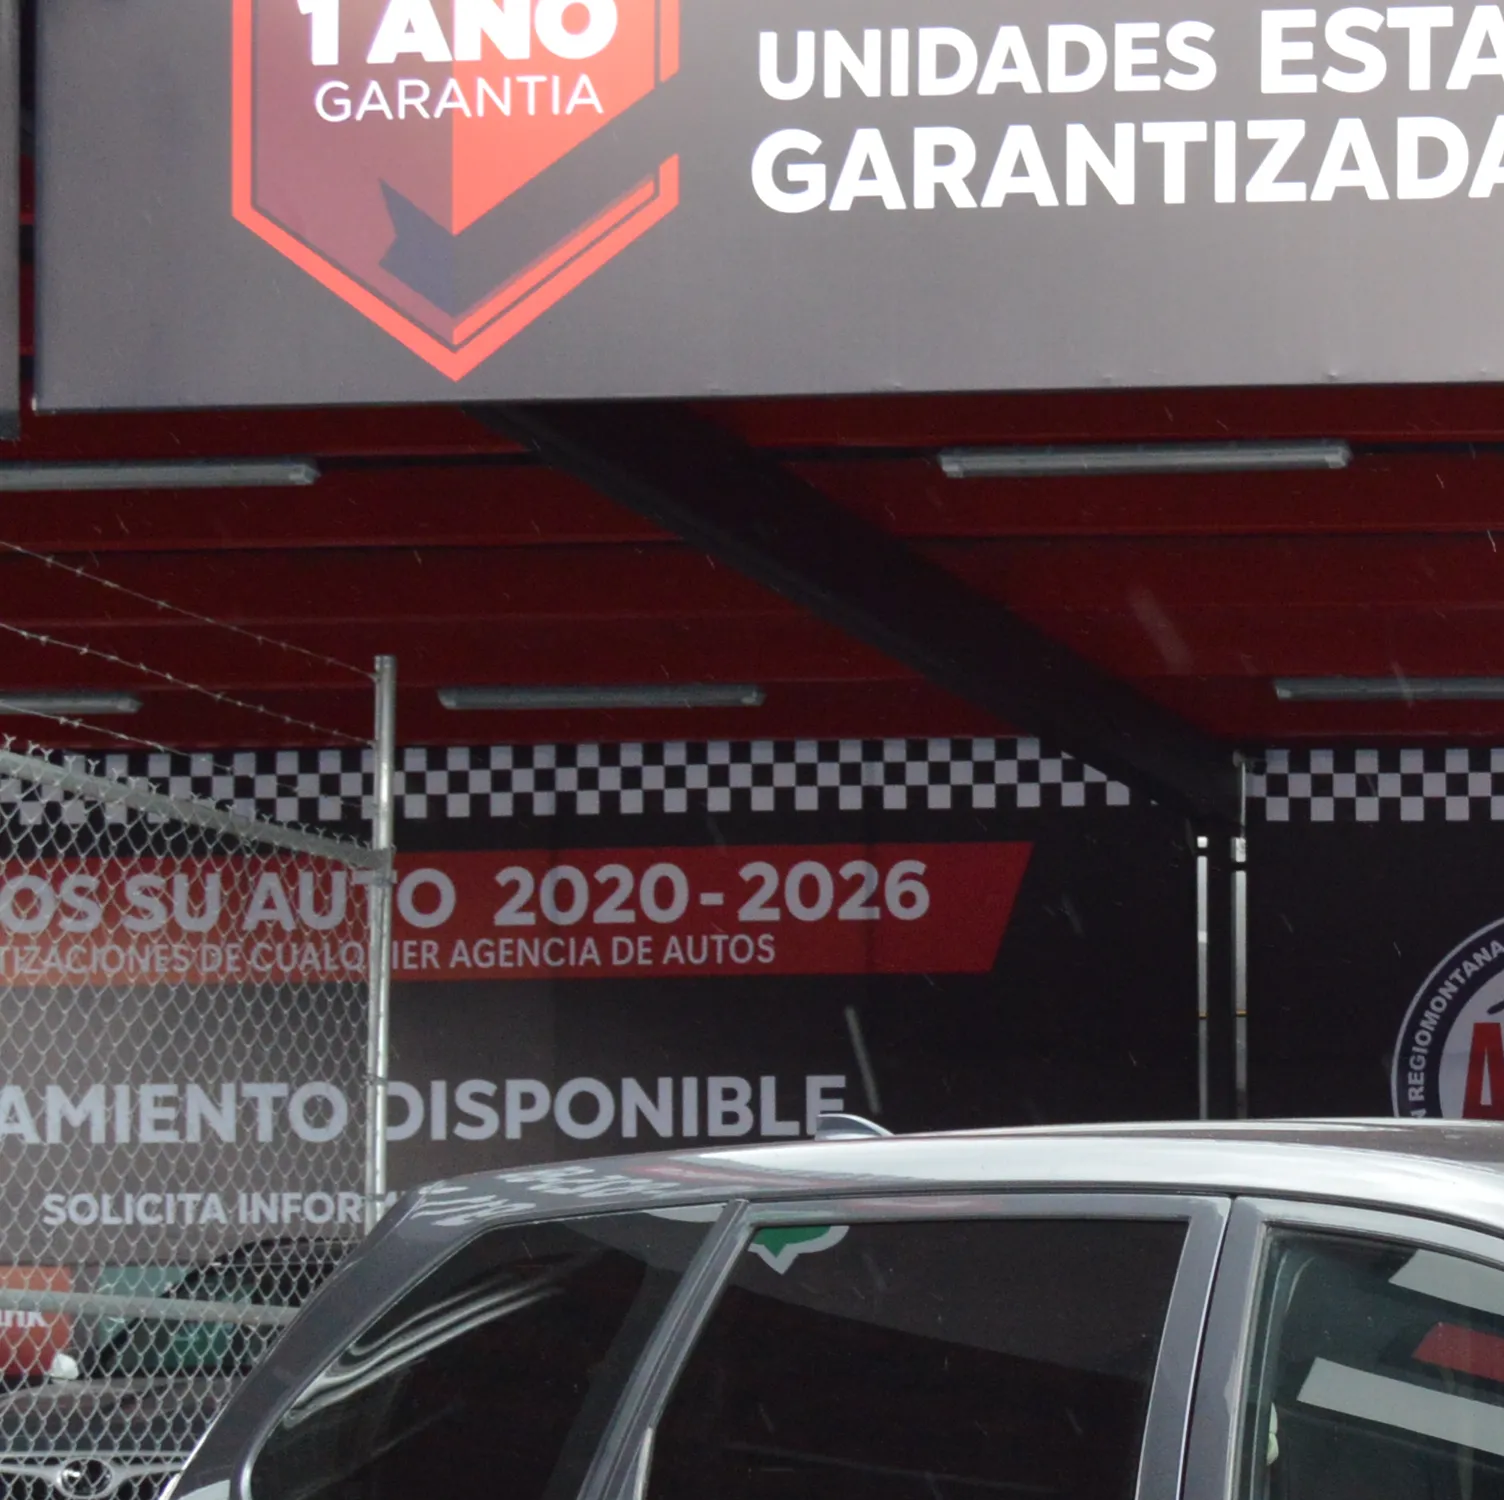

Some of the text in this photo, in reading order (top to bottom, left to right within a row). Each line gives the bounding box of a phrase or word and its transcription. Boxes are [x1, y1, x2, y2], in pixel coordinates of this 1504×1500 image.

[756, 21, 1217, 99] UNIDADES
[314, 73, 605, 123] GARANTIA
[121, 871, 222, 933] SU
[201, 942, 242, 973] DE
[249, 939, 441, 975] CUALQIER
[449, 936, 601, 969] AGENCIA
[611, 935, 653, 965] DE
[662, 933, 776, 964] AUTOS
[42, 1191, 397, 1226] SOLICITA INFOR
